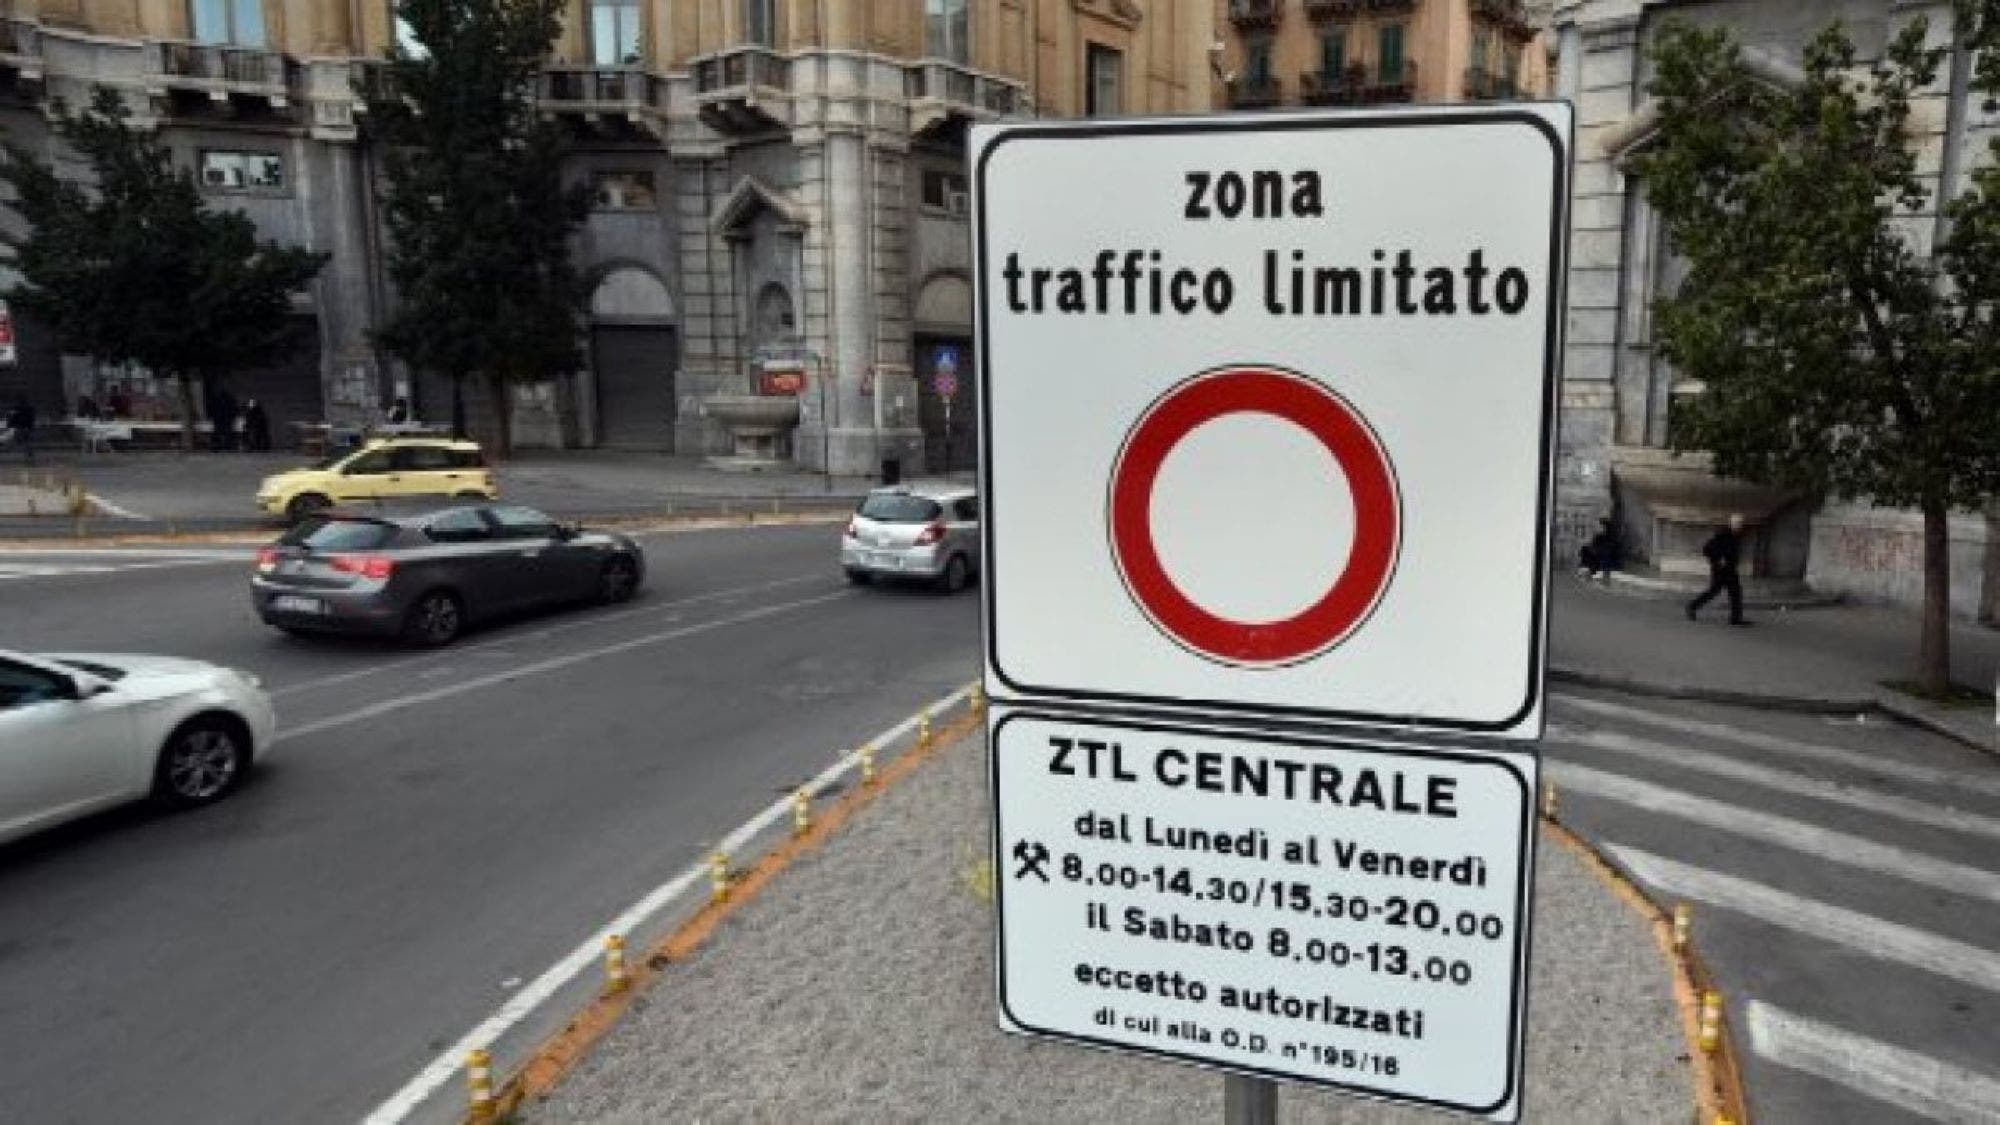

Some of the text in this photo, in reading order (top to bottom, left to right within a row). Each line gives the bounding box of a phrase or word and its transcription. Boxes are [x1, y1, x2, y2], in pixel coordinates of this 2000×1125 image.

[1184, 170, 1325, 221] zona
[1003, 247, 1528, 316] traffico limitato
[1048, 736, 1458, 819] ZTL CENTRALE
[1074, 809, 1487, 888] dal Lunedì al Venerdì
[1087, 901, 1472, 987] il Sabato 8.00-13.00
[1074, 962, 1425, 1040] eccetto autorizzati
[1093, 1006, 1116, 1026] di
[1123, 1016, 1159, 1036] cui
[1166, 1020, 1212, 1044] alla
